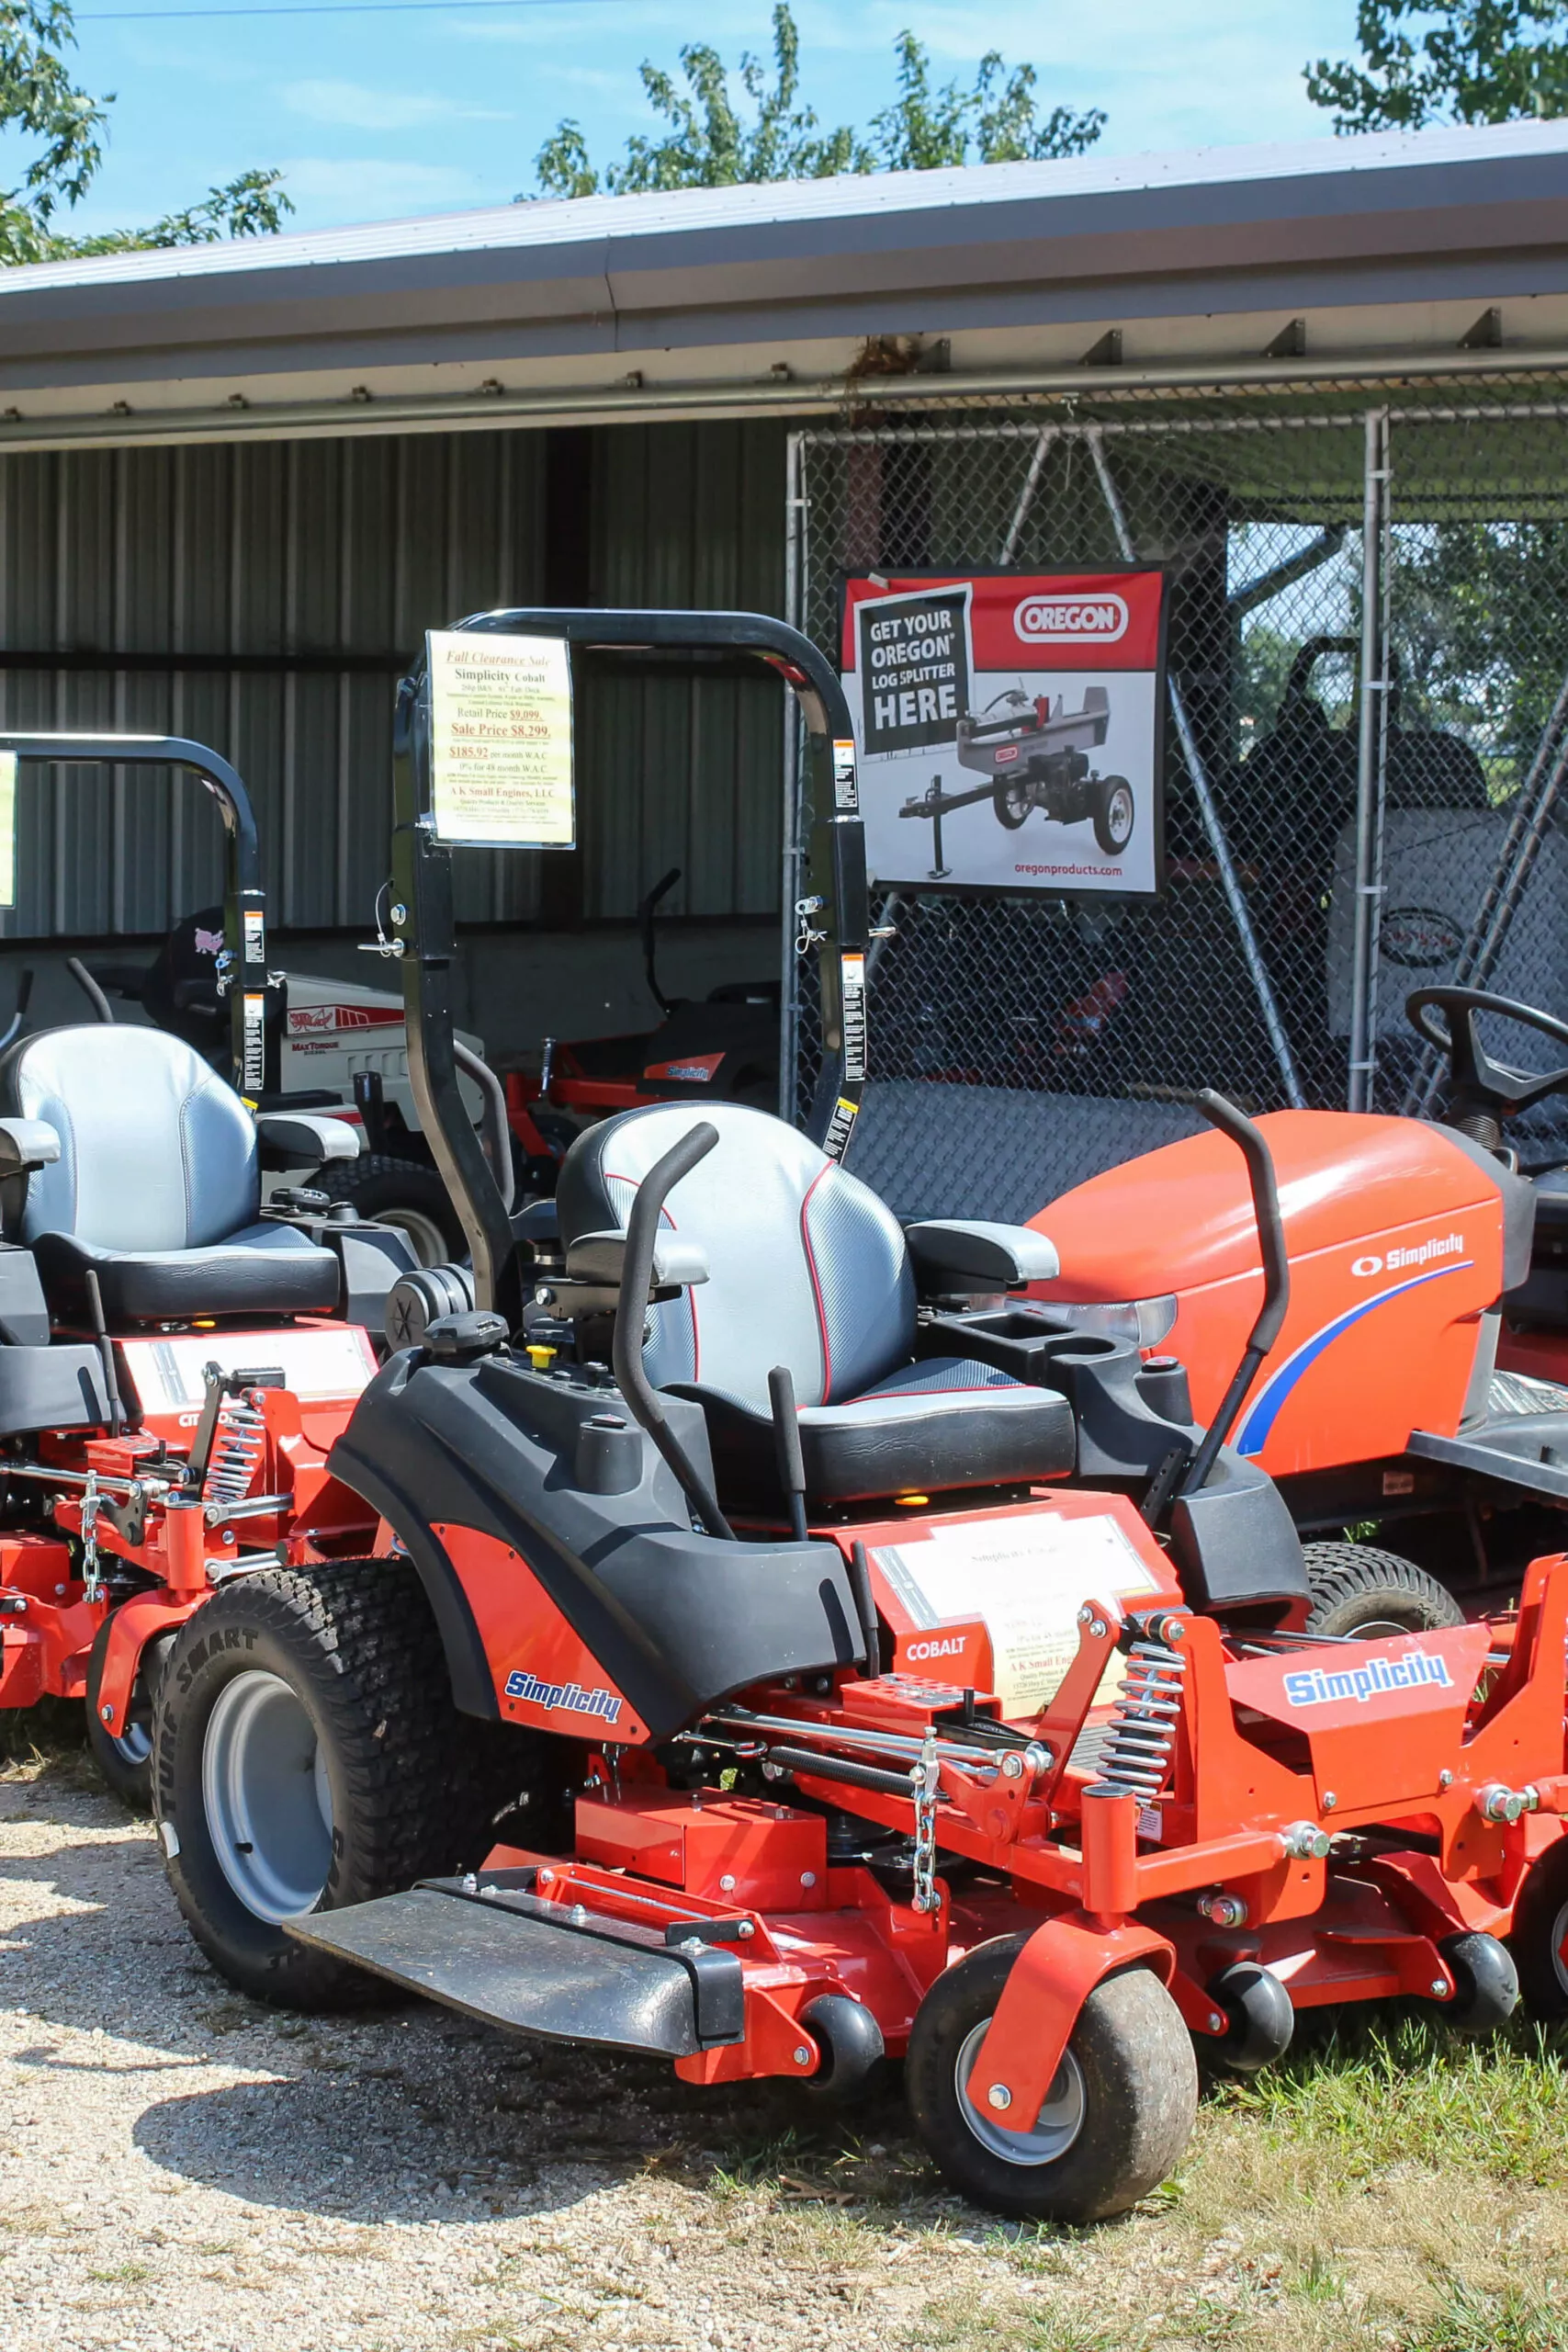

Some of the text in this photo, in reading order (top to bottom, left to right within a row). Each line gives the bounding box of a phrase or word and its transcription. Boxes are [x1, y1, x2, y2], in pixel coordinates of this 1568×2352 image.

[870, 610, 952, 641] GET YOUR
[1025, 606, 1114, 630] OREGON
[446, 650, 551, 667] Fall Clearance Sale
[455, 668, 546, 684] Simplicity Cobalt
[872, 662, 955, 690] LOG SPLITTER
[457, 707, 482, 718] Retail
[485, 707, 508, 719] Price
[874, 684, 957, 730] HERE
[451, 722, 476, 736] Sale
[479, 723, 508, 737] Price
[449, 745, 489, 760] $185.92
[491, 752, 502, 760] per
[502, 751, 525, 760] month
[474, 763, 485, 772] for
[497, 763, 520, 773] month
[459, 786, 467, 796] K
[469, 786, 493, 797] Small
[496, 787, 533, 798] Engines,
[535, 788, 556, 798] LLC
[1014, 863, 1122, 876] oregonproducts.com
[668, 1066, 709, 1081] Simplicity
[1386, 1233, 1463, 1271] Simplicity
[907, 1635, 967, 1661] COBALT
[1019, 1661, 1027, 1670] K
[1030, 1657, 1054, 1668] Small
[1283, 1650, 1455, 1707] Simplicity
[504, 1669, 623, 1724] Simplicity
[158, 1701, 178, 1816] TURF
[176, 1626, 259, 1694] SMART
